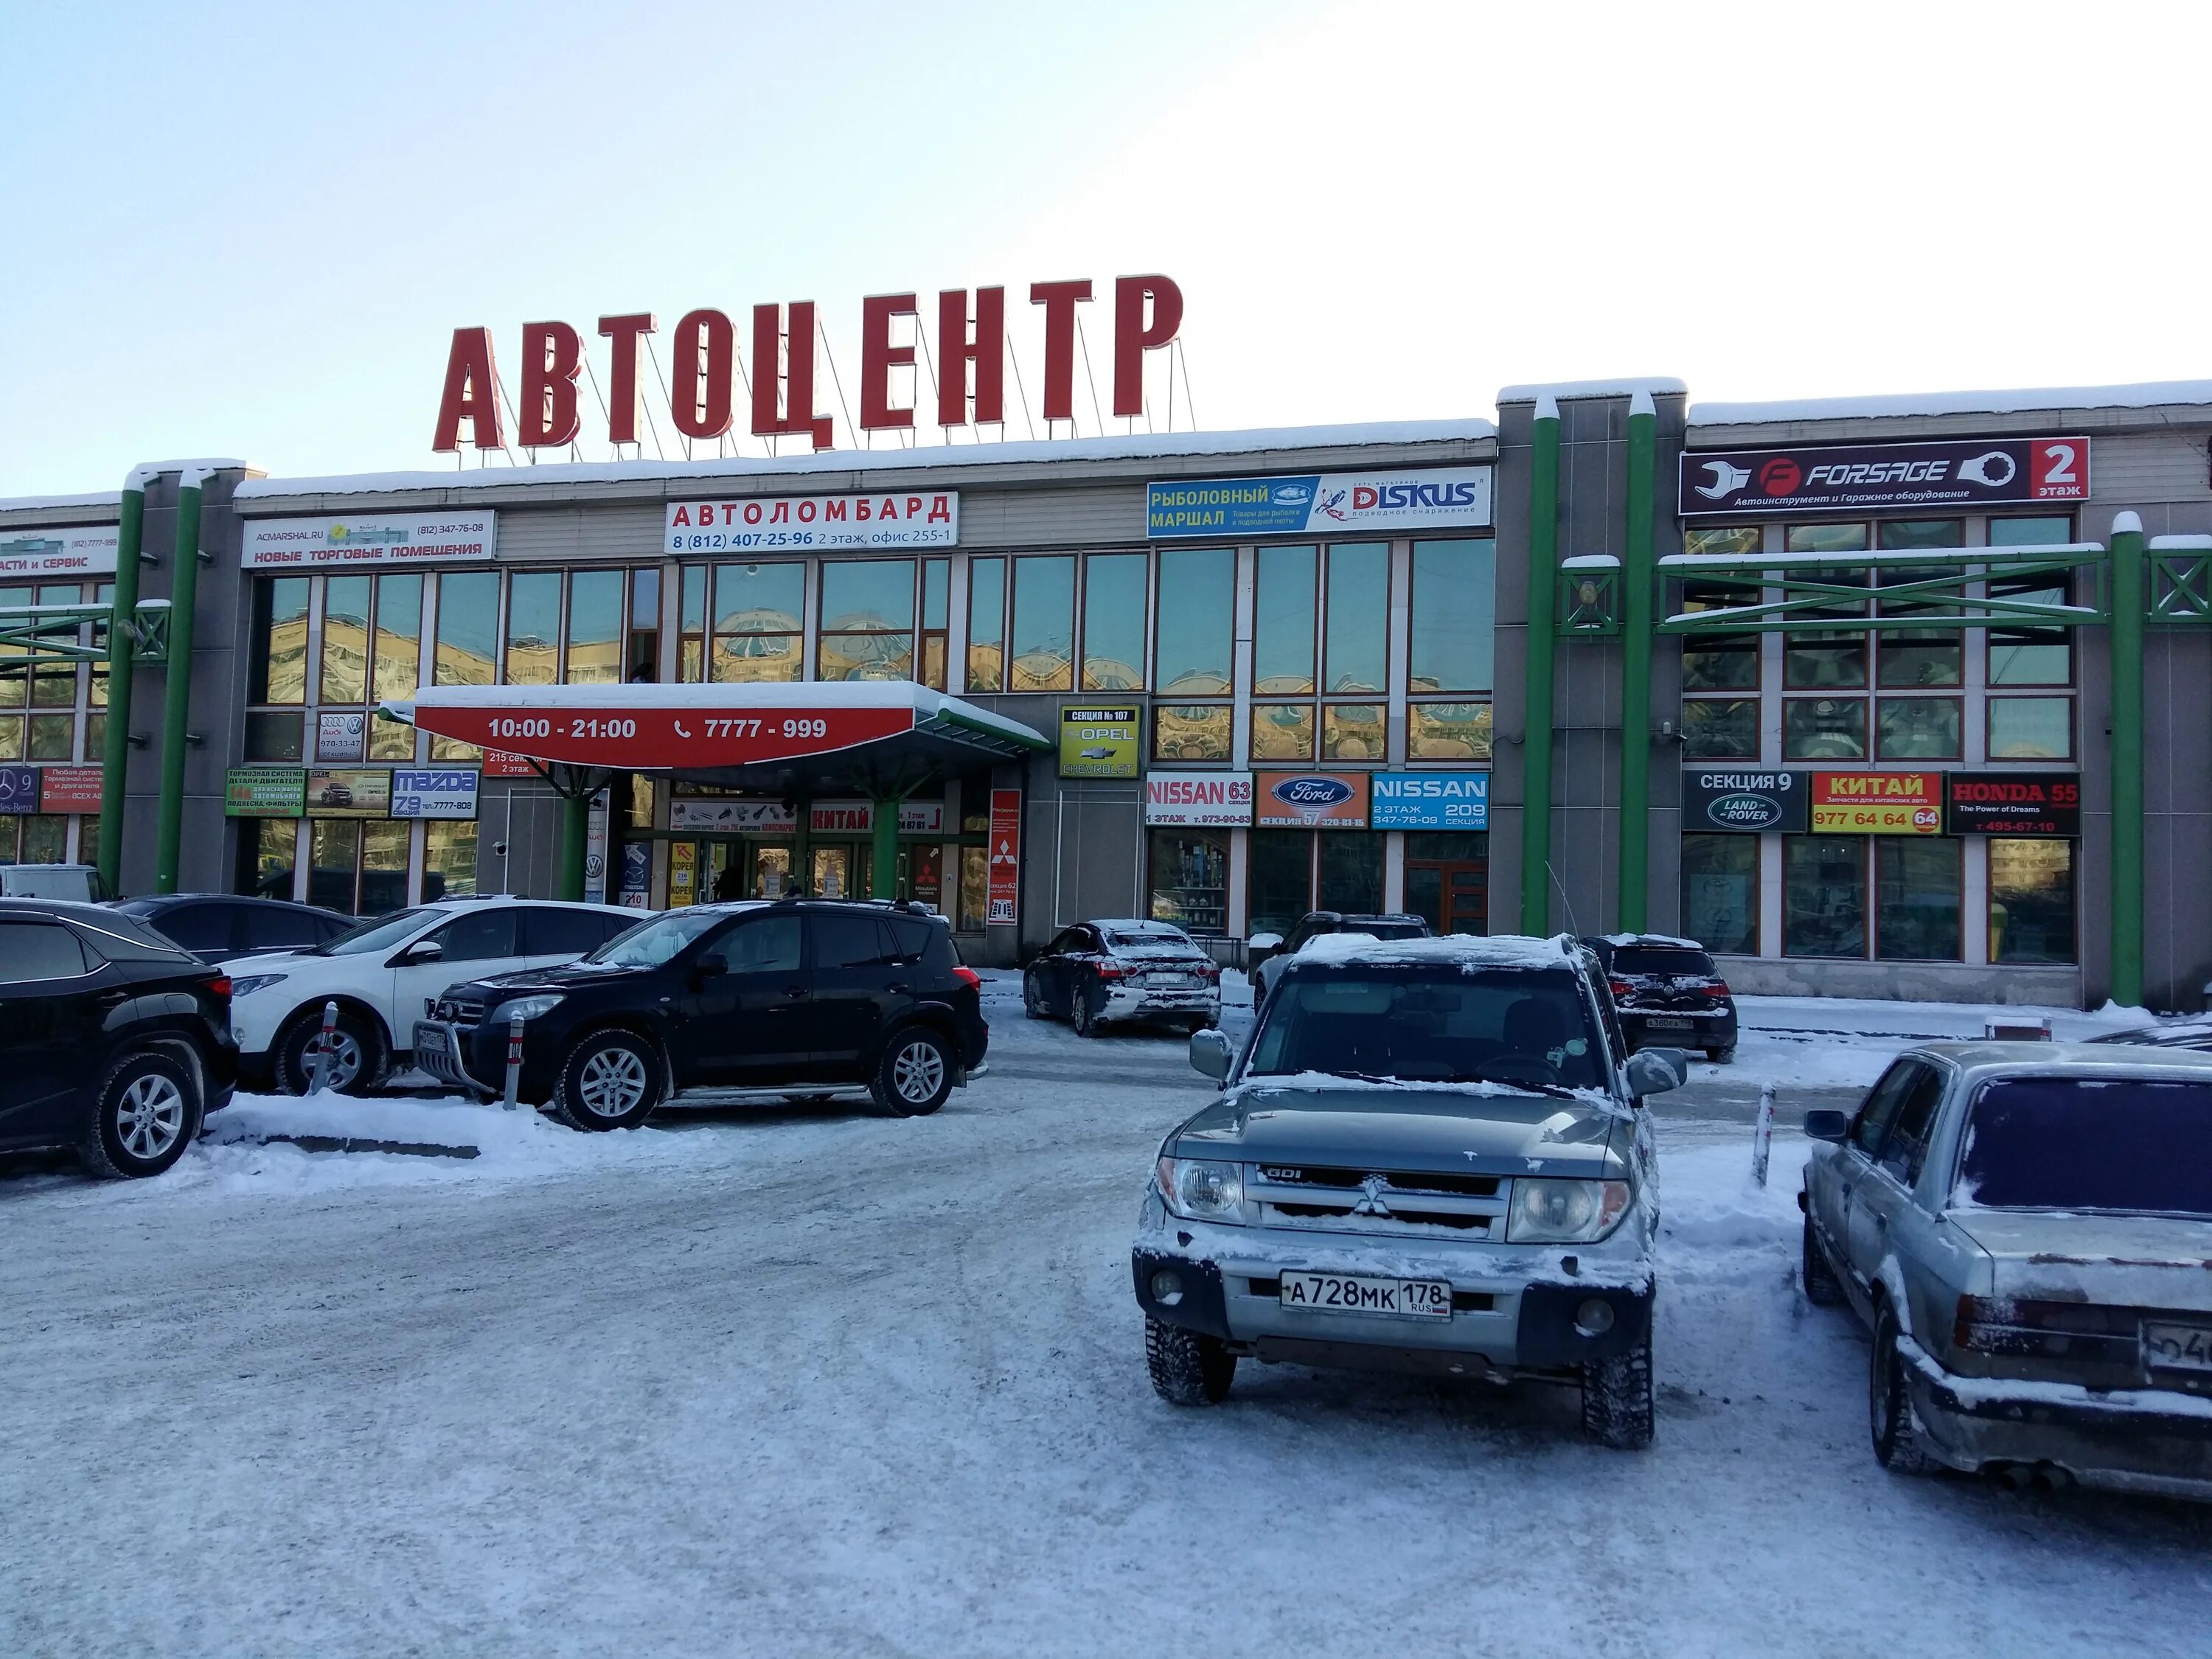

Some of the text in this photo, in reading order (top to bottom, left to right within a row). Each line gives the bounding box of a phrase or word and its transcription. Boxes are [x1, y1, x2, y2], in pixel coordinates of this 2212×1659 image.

[431, 274, 1184, 454] АВТОЦЕНТР
[2045, 445, 2076, 483] 2
[1806, 460, 1950, 486] FORSAGE
[1151, 485, 1268, 507] РЫБОЛОВНЫЙ
[1353, 482, 1475, 510] DISKUS
[2039, 486, 2081, 496] этаж
[1734, 495, 1829, 507] Автоинструмент
[1840, 493, 1893, 503] Гаражное
[1896, 490, 1970, 501] оборудование
[672, 495, 950, 527] АВТОЛОМБАРД
[1271, 509, 1300, 517] рыбалки
[1352, 507, 1475, 517] подводное снаряжение
[1150, 510, 1225, 527] МАРШАЛ
[256, 524, 484, 542] ACMARSHAL.RU (812) 347-76-08
[72, 538, 117, 549] (812) 7777-999
[672, 529, 951, 551] 8 (812) 407-25-96 2 этаж, офис 255-1
[254, 543, 483, 563] НОВЫЕ ТОРГОВЫЕ ПОМЕЩЕНИЯ
[31, 561, 38, 569] и
[43, 557, 88, 568] СЕРВИС
[1071, 711, 1128, 722] СЕКЦИЯ № 107
[488, 718, 636, 739] 10:00 21:00
[704, 718, 827, 738] 7777 999
[1080, 728, 1135, 740] OPEL
[490, 753, 507, 762] 215
[502, 764, 507, 773] 2
[1062, 764, 1133, 774] CHEVROLET
[21, 774, 31, 790] 9
[1700, 773, 1792, 792] СЕКЦИЯ 9
[1831, 774, 1923, 796] КИТАЙ
[43, 791, 50, 799] 5
[1147, 782, 1251, 804] NISSAN 63
[1290, 782, 1335, 801] Ford
[1374, 780, 1486, 798] NISSAN
[1953, 783, 2078, 801] HONDA 55
[394, 796, 422, 810] 79
[434, 801, 473, 810] 7777-808
[1373, 805, 1422, 813] 2 ЭТАЖ
[1724, 801, 1758, 810] LAND
[1445, 804, 1486, 816] 209
[1726, 810, 1769, 820] ROVER
[812, 807, 869, 830] КИТАЙ
[1146, 814, 1151, 823] 1
[1155, 815, 1186, 823] ЭТАЖ
[1259, 810, 1365, 827] СЕКЦИЯ 57 320-81-15
[1445, 818, 1485, 827] СЕКЦИЯ
[1814, 812, 1907, 826] 977 64 64
[1913, 812, 1937, 824] 64
[906, 821, 916, 830] 67
[917, 821, 925, 830] 61
[1986, 821, 2055, 832] 495-67-10
[672, 861, 694, 871] КОРЕЯ
[671, 886, 693, 895] КОРЕЯ
[1266, 1167, 1301, 1179] GDI
[1290, 1277, 1442, 1310] А728МК 178
[1411, 1304, 1431, 1312] RUS
